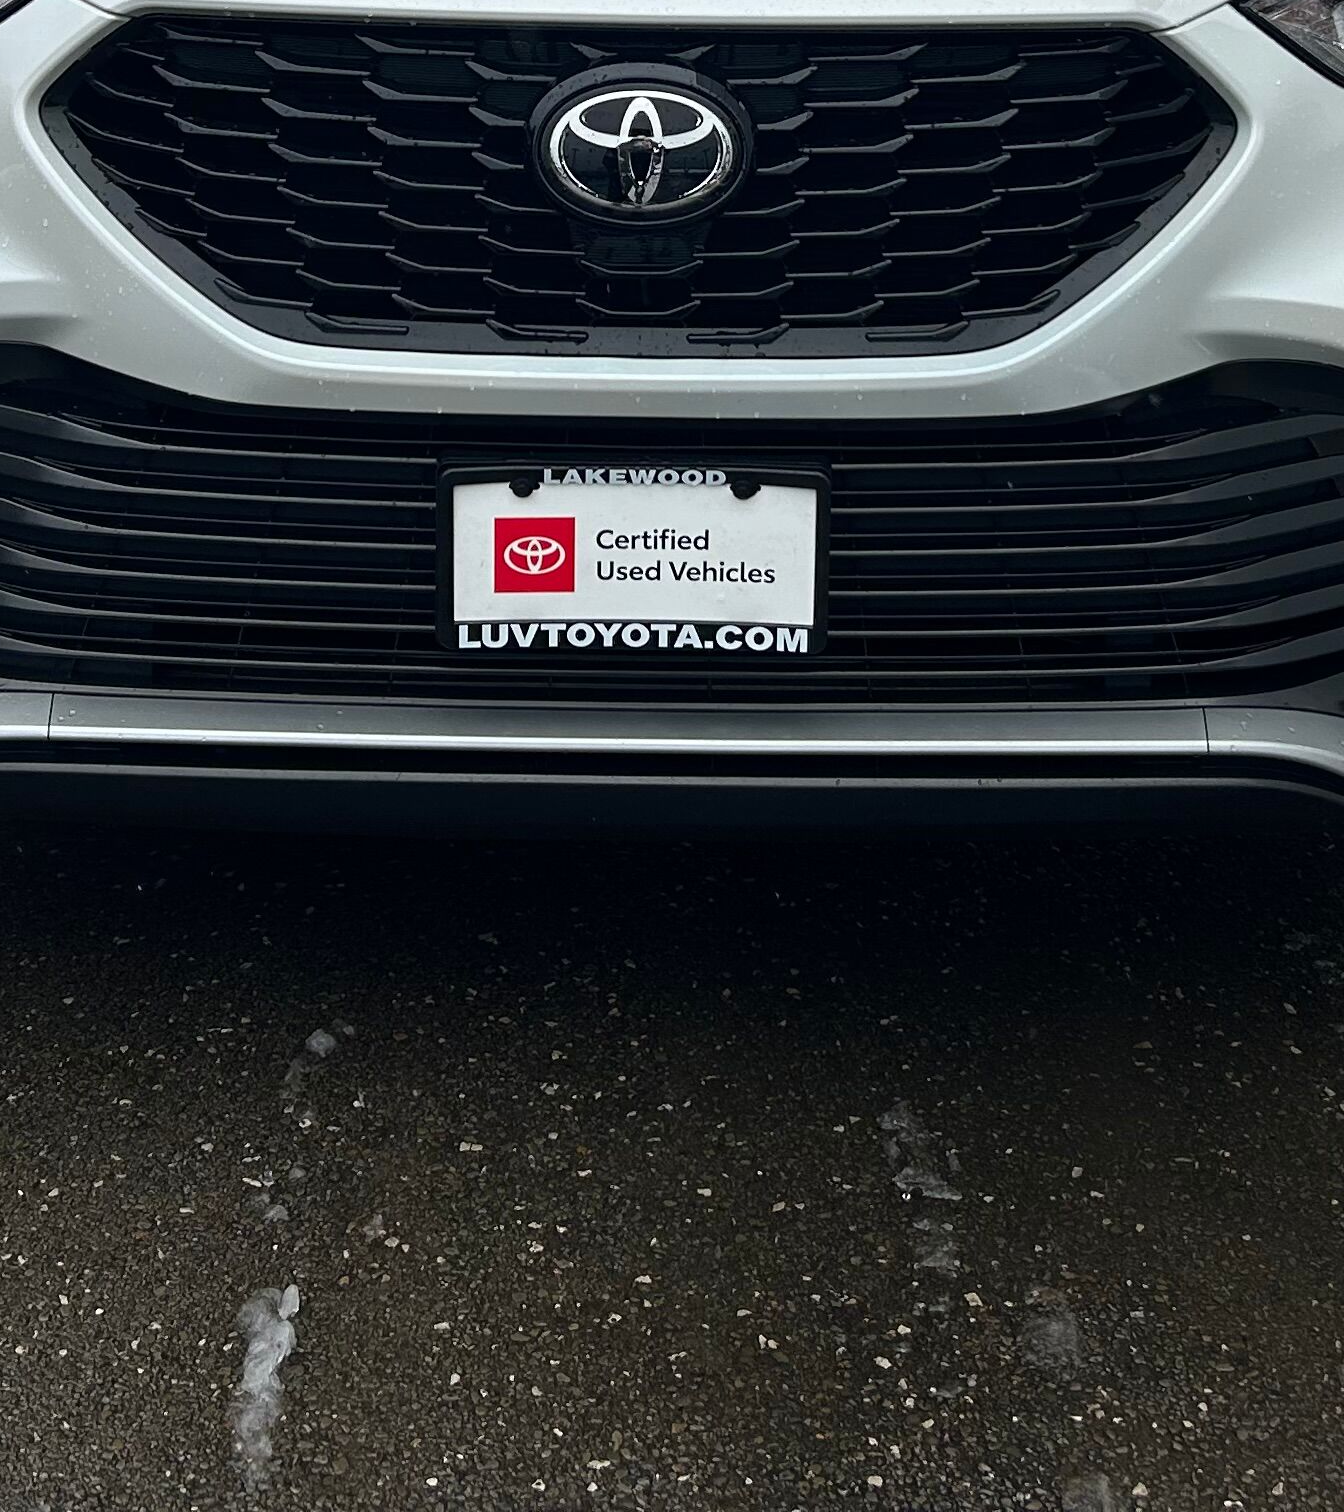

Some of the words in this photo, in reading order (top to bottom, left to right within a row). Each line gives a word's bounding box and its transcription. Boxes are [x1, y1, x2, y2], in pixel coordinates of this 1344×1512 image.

[543, 467, 727, 486] LAKEWOOD
[595, 528, 710, 551] Certified
[595, 560, 662, 581] Used
[668, 560, 776, 584] Vehicles
[458, 622, 809, 653] LUVTOYOTA.COM
